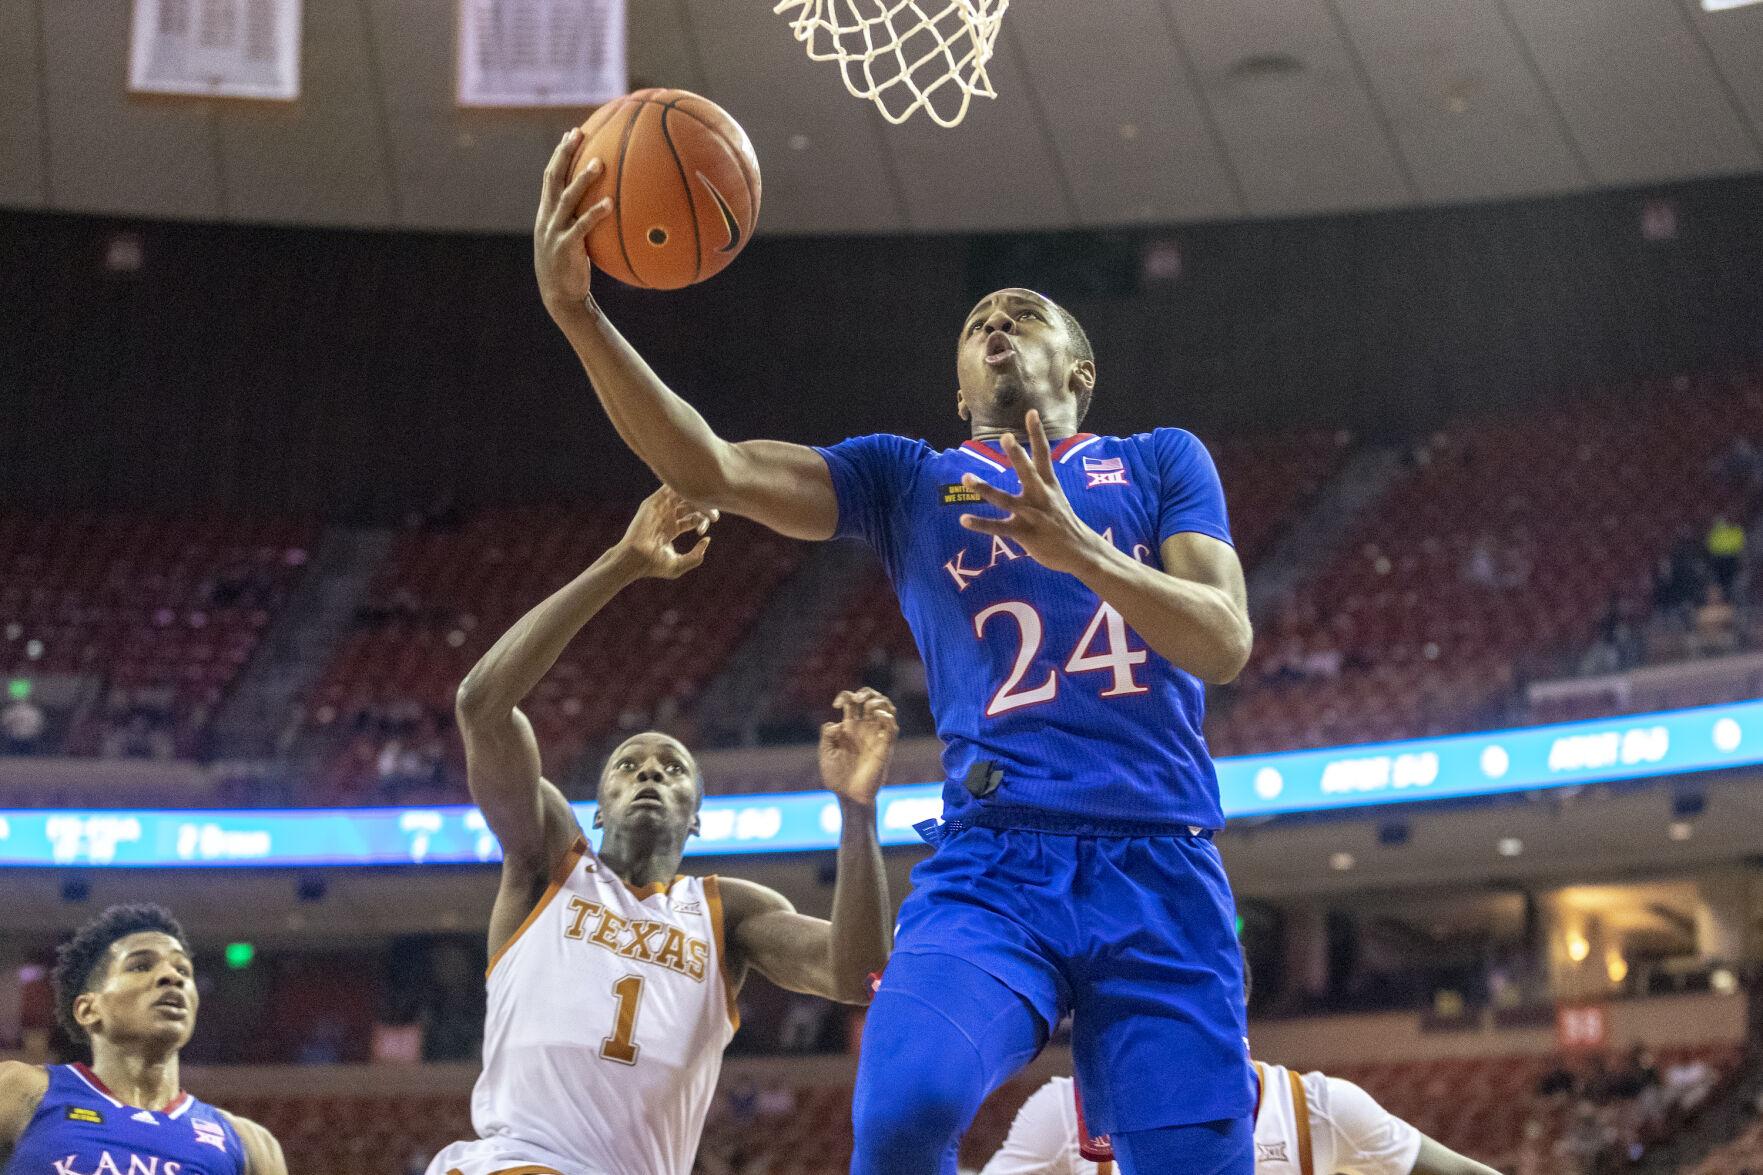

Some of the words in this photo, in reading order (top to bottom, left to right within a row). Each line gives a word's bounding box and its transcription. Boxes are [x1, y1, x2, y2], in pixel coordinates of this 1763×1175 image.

[973, 600, 1149, 717] 24
[564, 895, 709, 983] TEXAS
[600, 974, 645, 1066] 1
